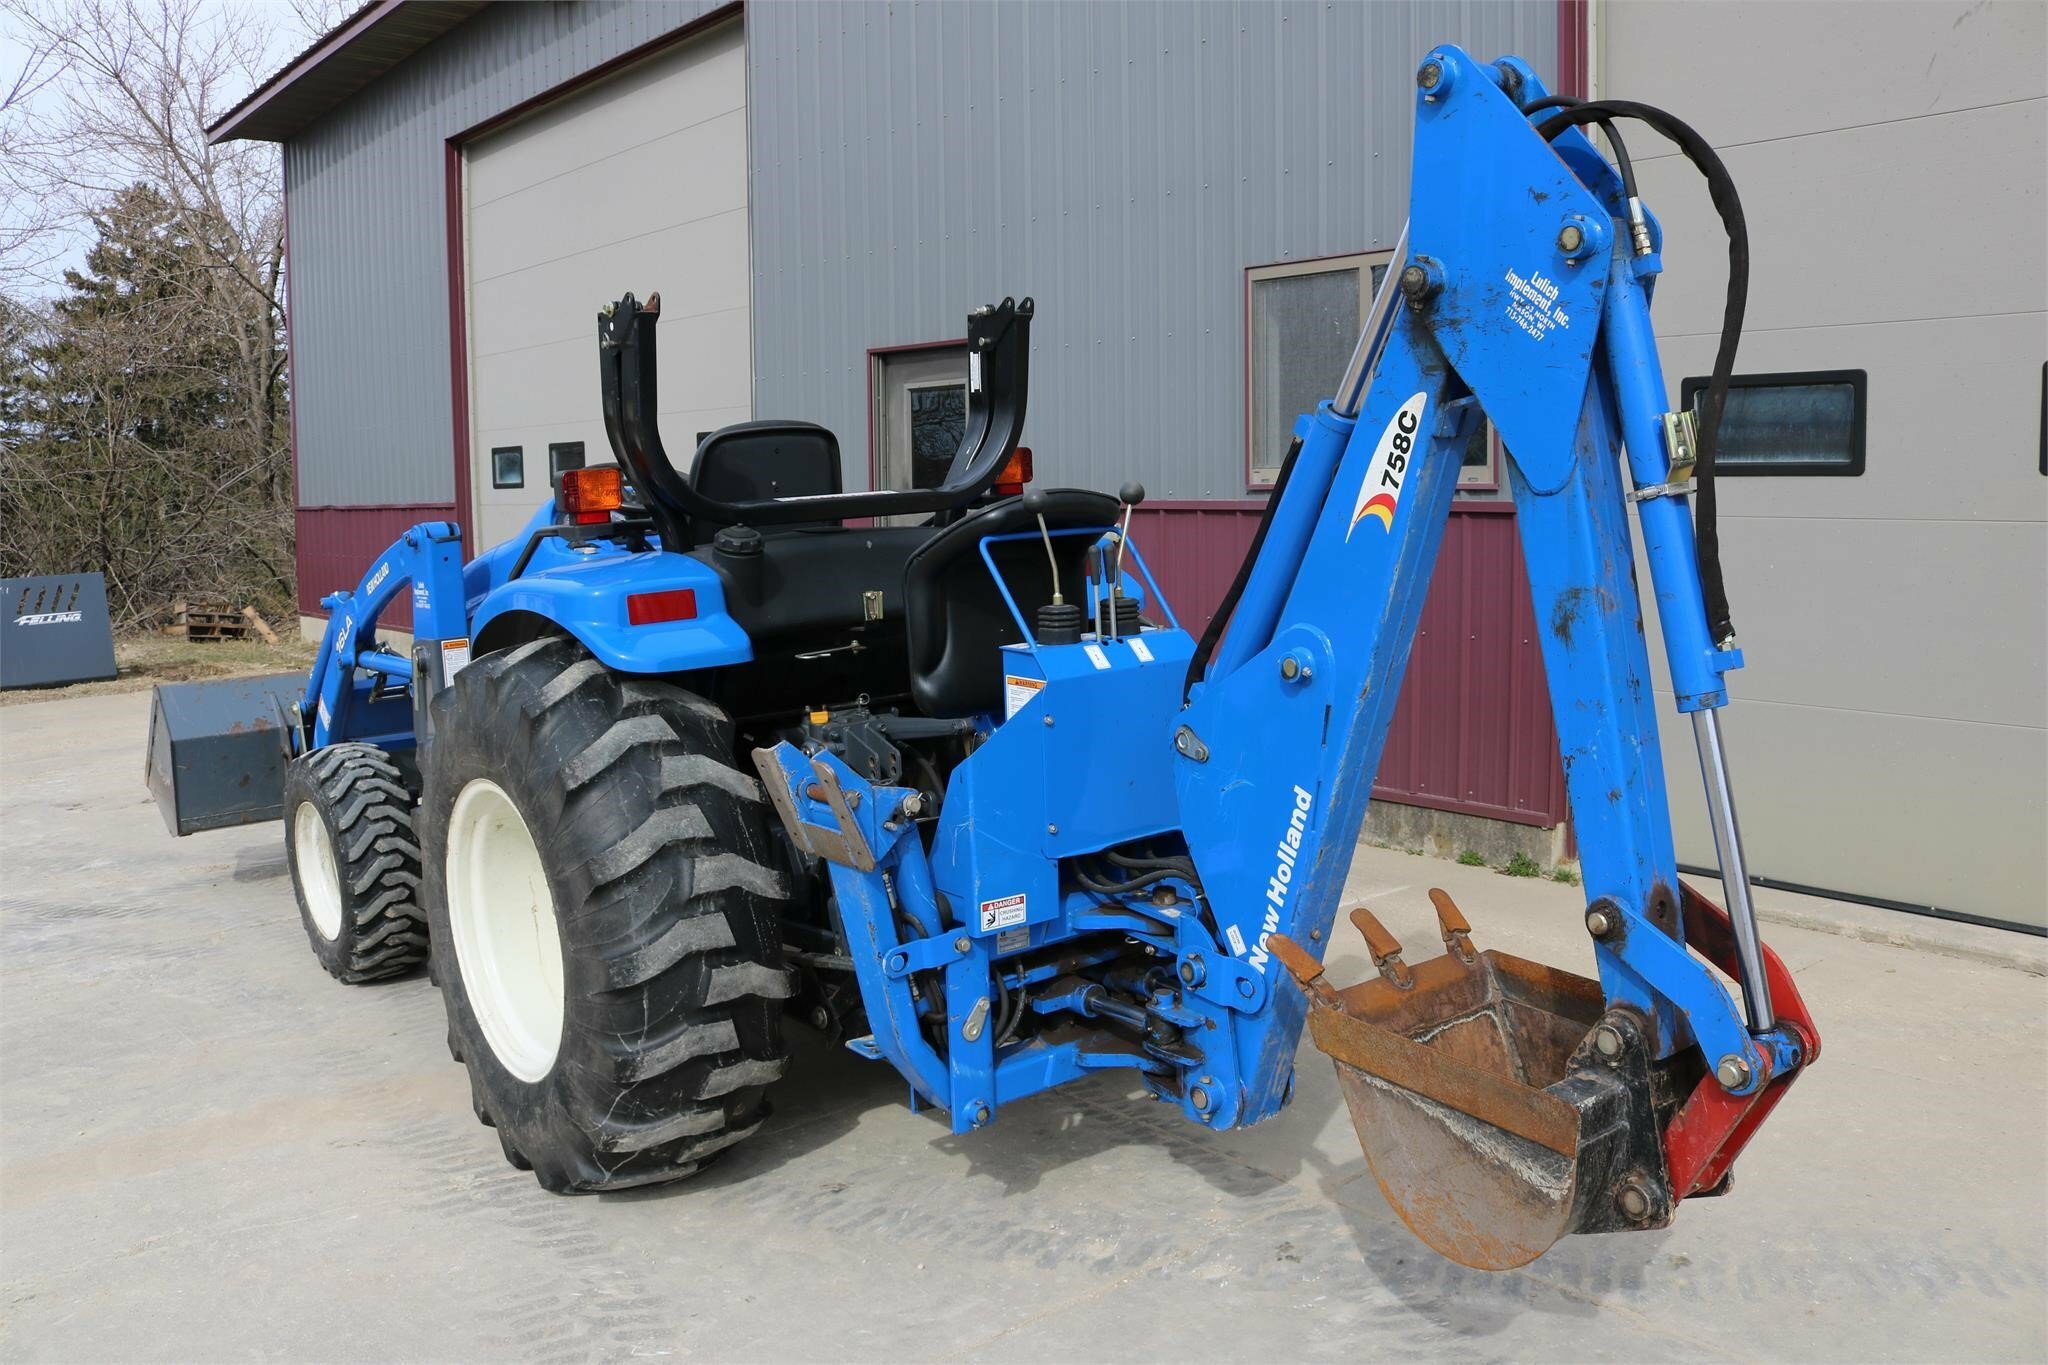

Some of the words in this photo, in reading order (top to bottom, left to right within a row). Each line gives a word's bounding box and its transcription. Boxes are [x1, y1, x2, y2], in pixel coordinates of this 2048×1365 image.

[1504, 267, 1552, 317] Implement,
[1552, 306, 1569, 329] Inc.
[1530, 271, 1559, 301] Lulich
[1504, 306, 1545, 342] 715-746-2477
[1534, 310, 1556, 330] NORTH
[1381, 410, 1418, 490] 758C
[15, 611, 82, 626] FELLING
[336, 615, 353, 653] 16LA
[1248, 904, 1281, 975] New
[1266, 784, 1313, 907] Holland
[994, 897, 1021, 910] DANGER
